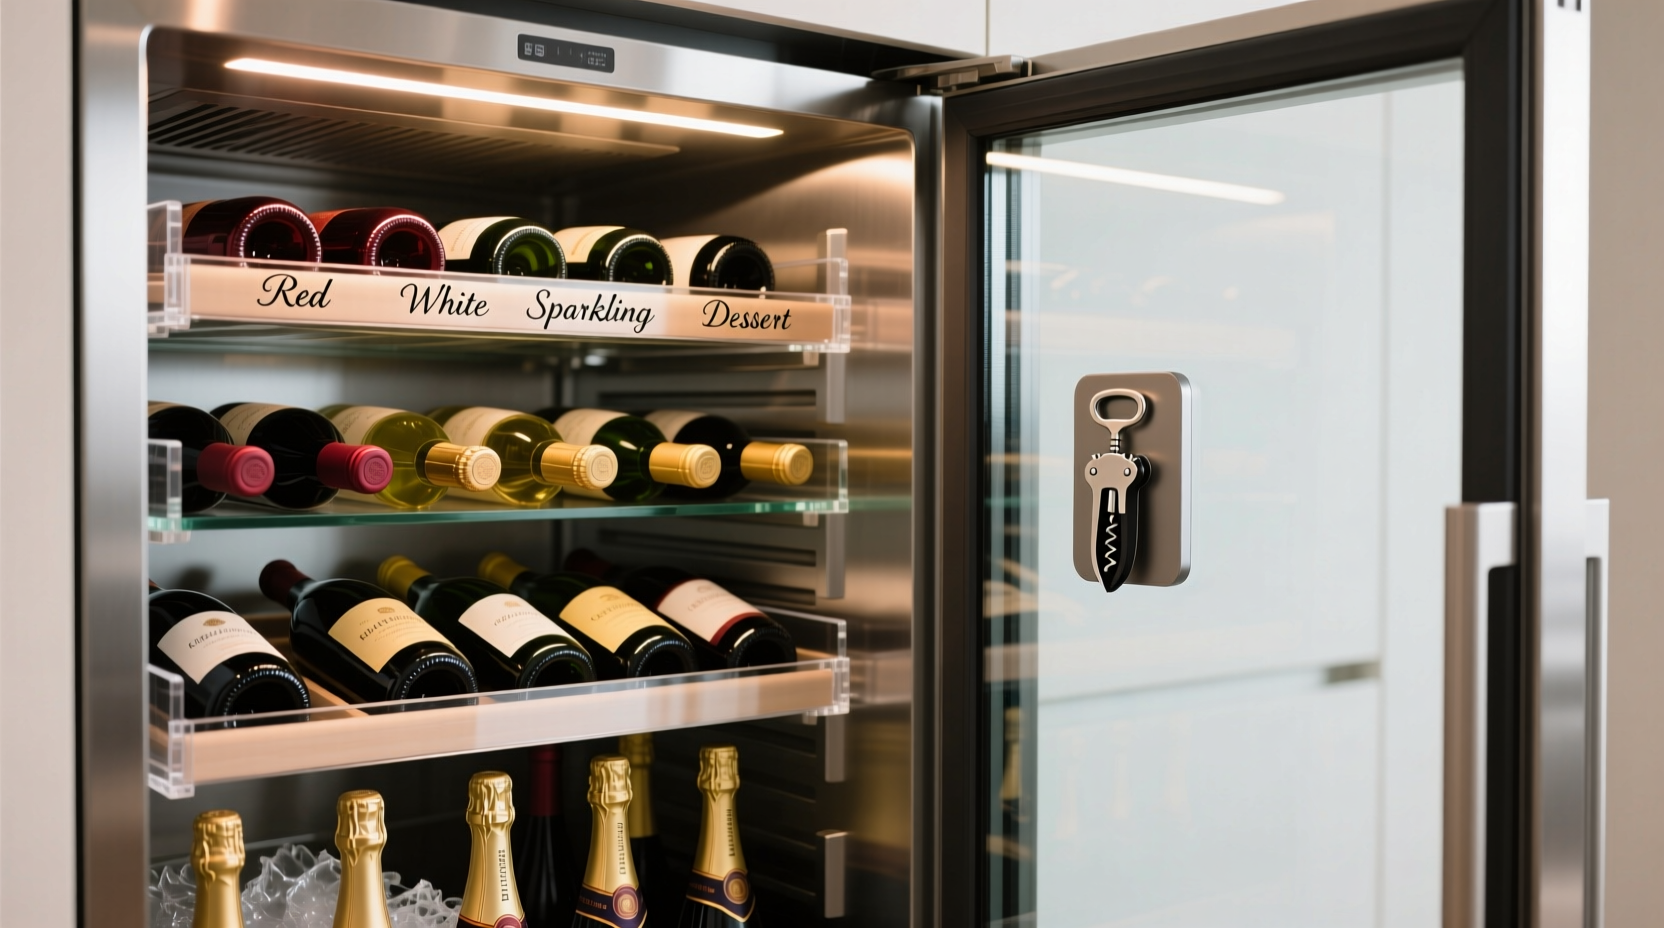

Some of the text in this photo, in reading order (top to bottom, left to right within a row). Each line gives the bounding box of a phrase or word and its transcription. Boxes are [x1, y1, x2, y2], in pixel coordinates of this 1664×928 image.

[257, 273, 793, 335] Red White Sparkling Dessert
